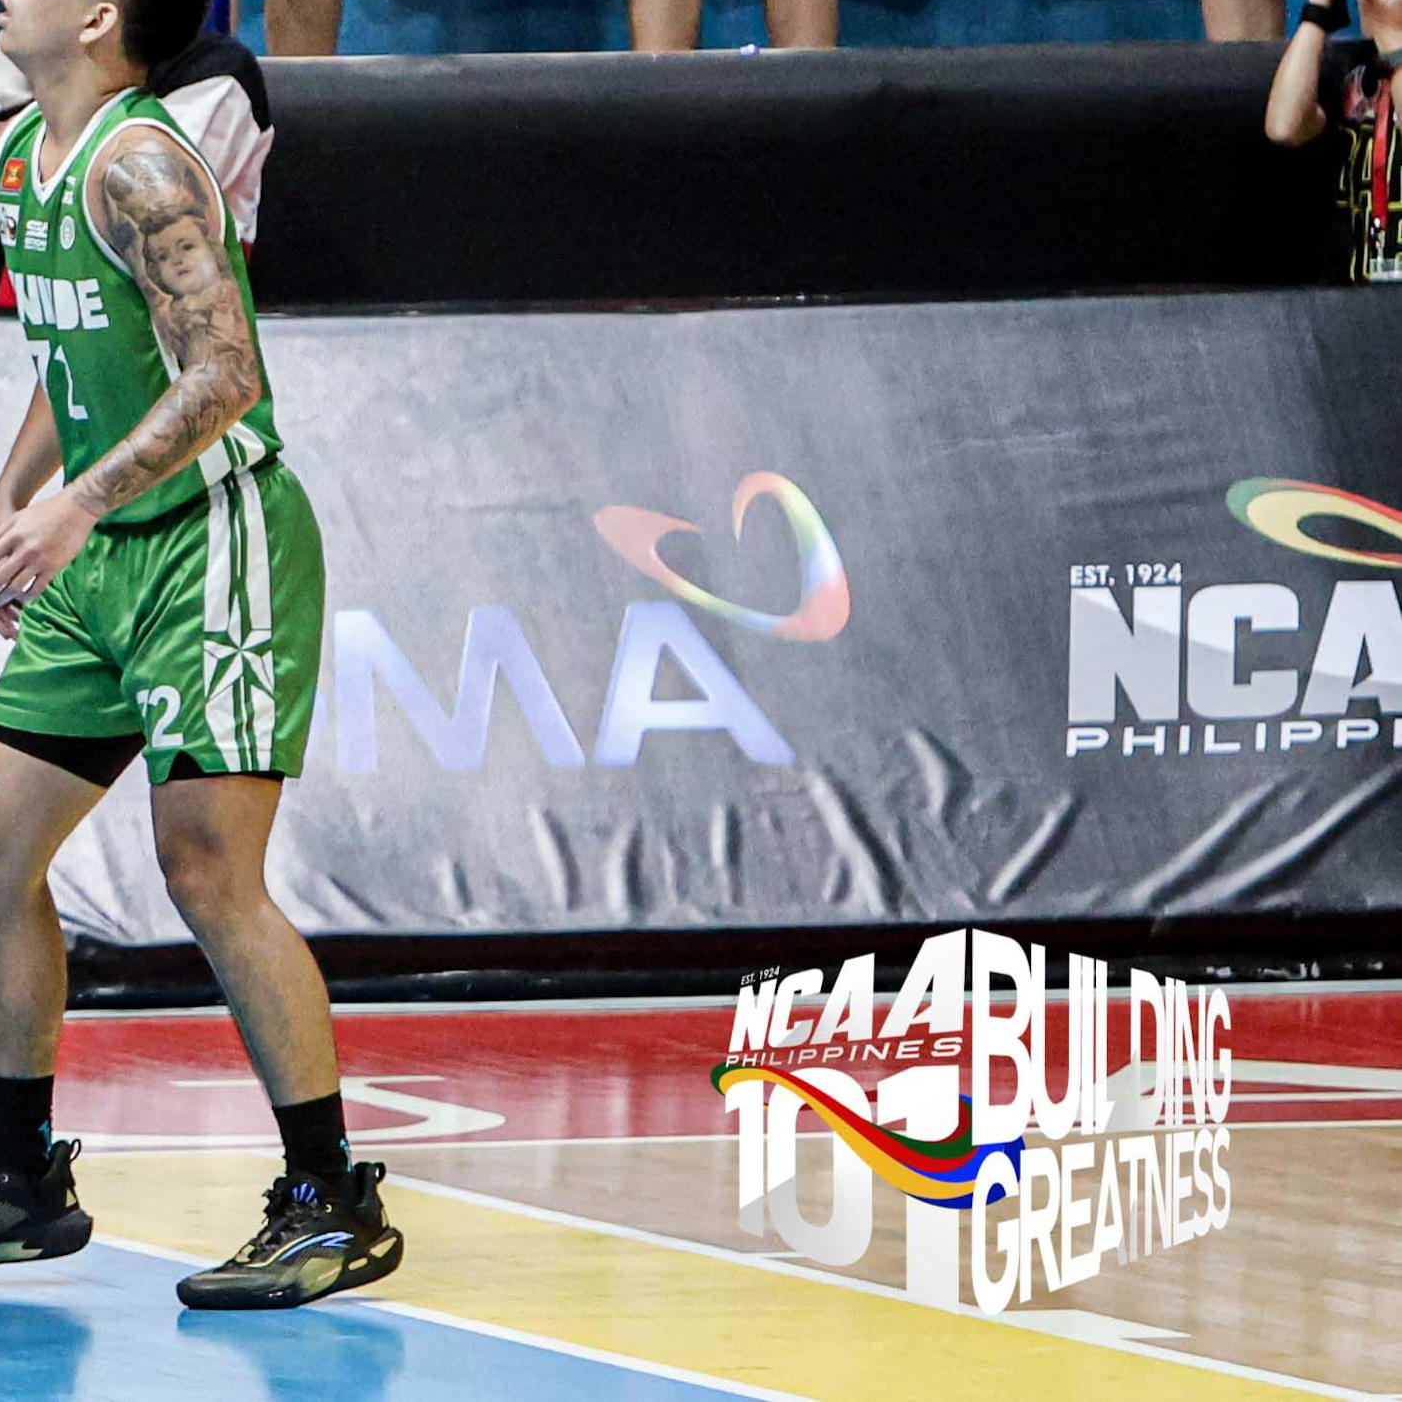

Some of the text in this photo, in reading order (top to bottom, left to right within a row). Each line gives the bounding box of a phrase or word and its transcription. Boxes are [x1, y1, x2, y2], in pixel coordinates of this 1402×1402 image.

[1125, 561, 1183, 585] 1924
[306, 600, 797, 775] MA
[1067, 579, 1402, 724] NCA
